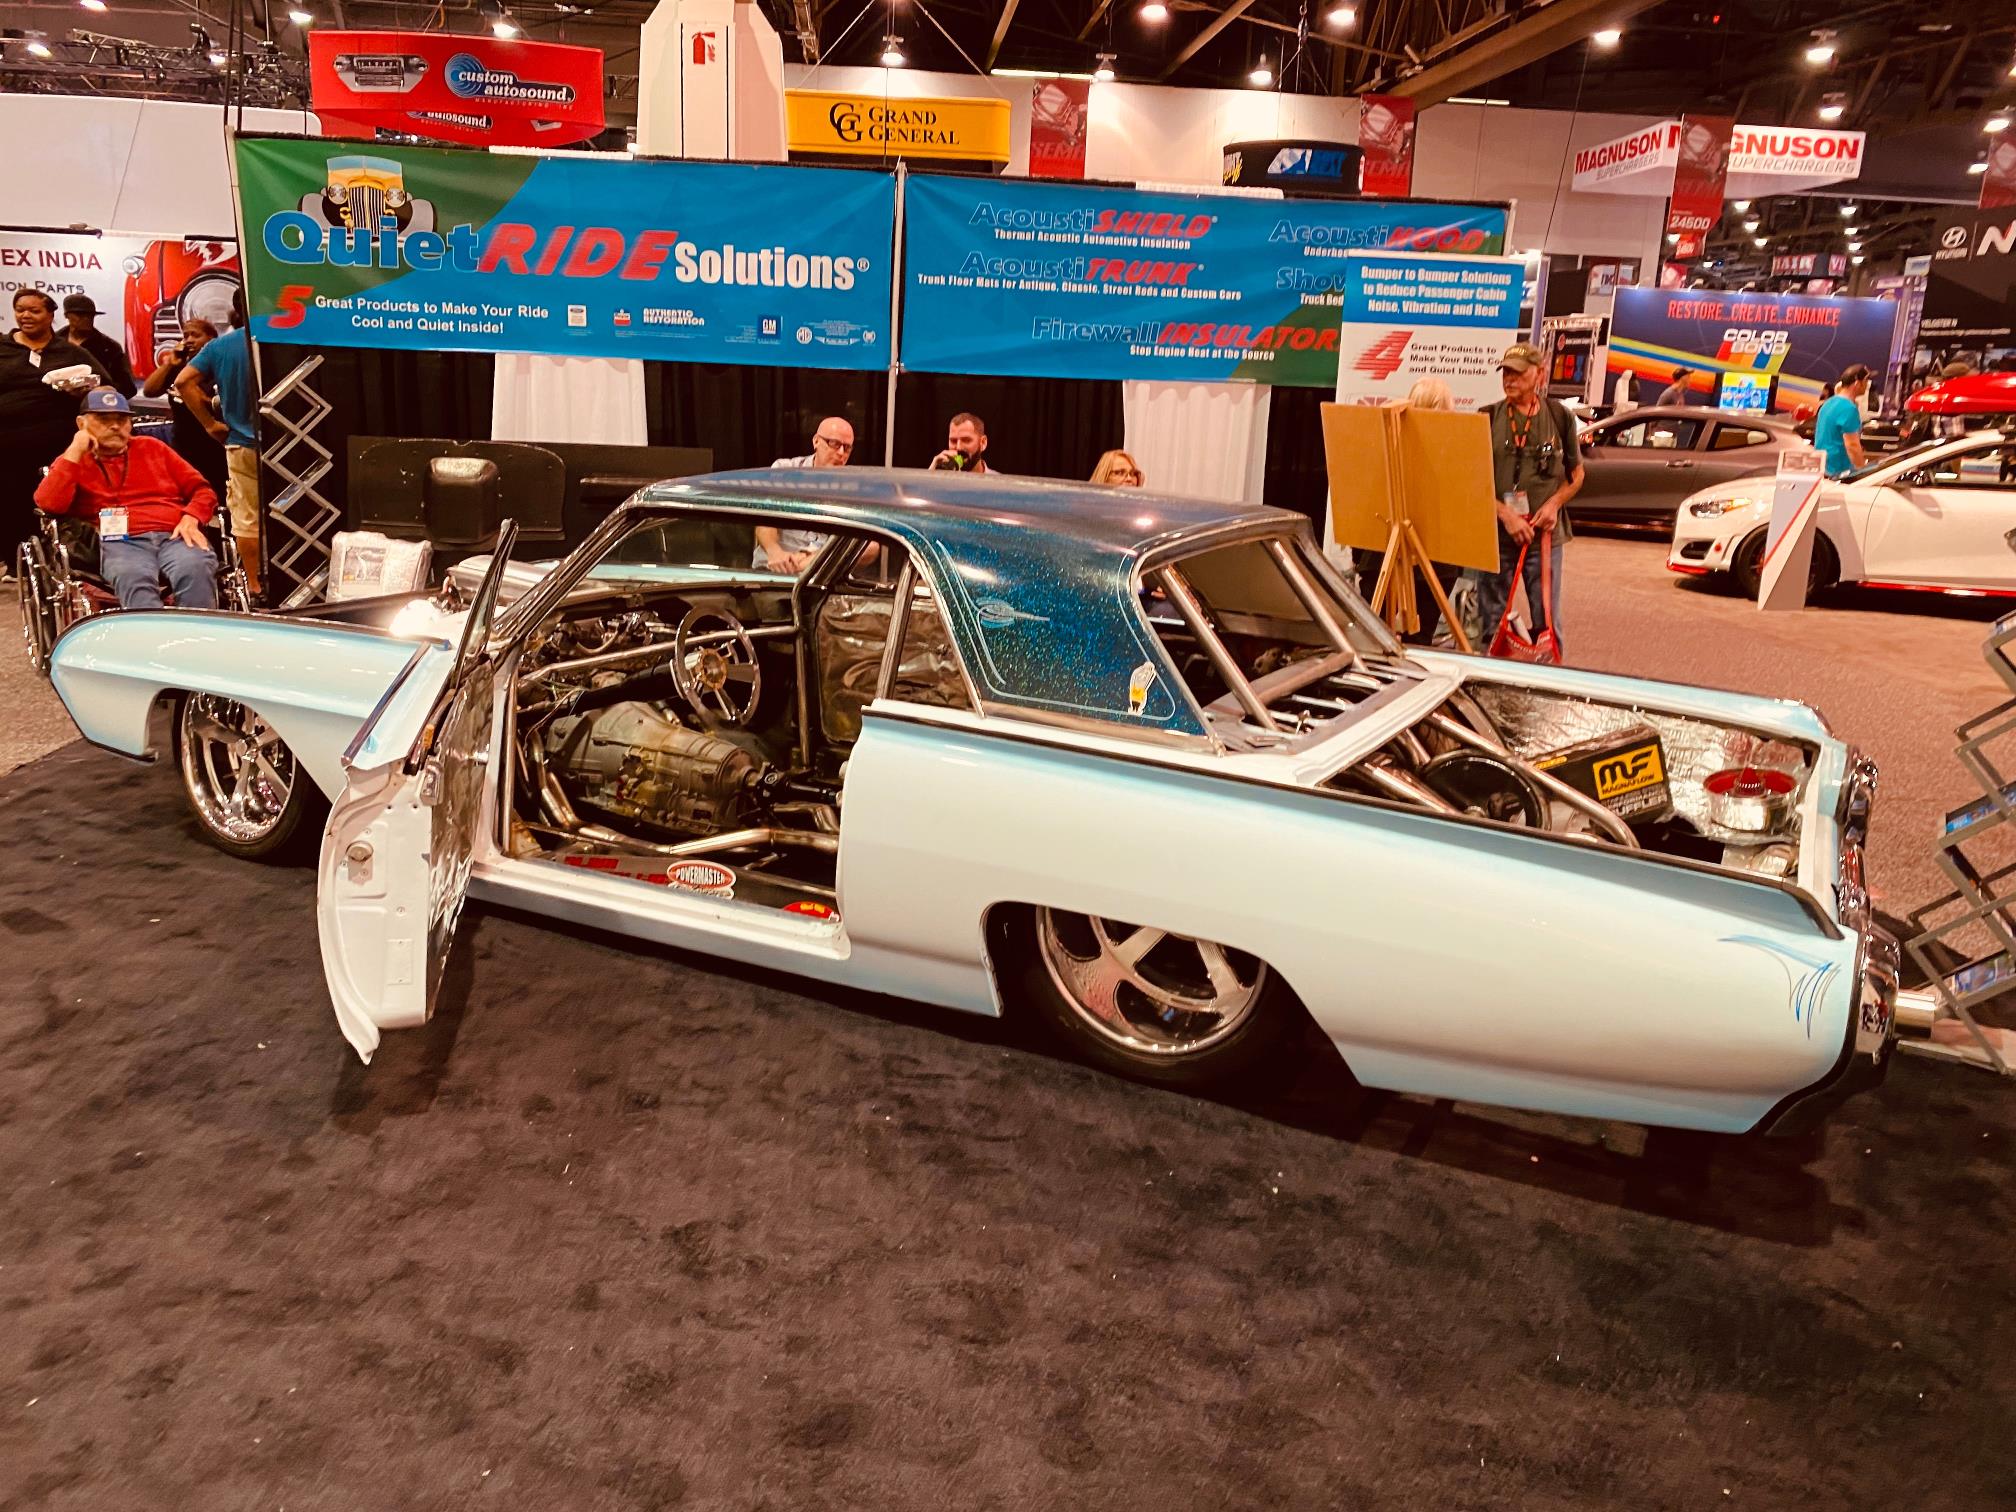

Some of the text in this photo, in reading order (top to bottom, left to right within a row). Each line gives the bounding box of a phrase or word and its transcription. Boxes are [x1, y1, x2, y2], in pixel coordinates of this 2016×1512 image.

[458, 70, 514, 85] custom
[869, 106, 937, 126] GRAND
[869, 125, 960, 145] GENERAL
[1575, 129, 1663, 175] MAGNUSON
[1596, 153, 1660, 181] SUPERCHARGERS
[994, 228, 1191, 250] Thermal Acoustic Automotive Insulation
[38, 251, 103, 270] INDIA
[1361, 265, 1512, 286] Bumper to Bumper Solutions
[918, 273, 946, 286] Trunk
[948, 275, 973, 287] Floor
[976, 277, 1000, 289] Mats
[1002, 278, 1016, 290] for
[1103, 283, 1132, 295] Street
[1135, 285, 1158, 297] Rods
[1160, 287, 1178, 298] and
[1181, 288, 1217, 300] Custom
[1219, 289, 1242, 301] Cars
[1363, 282, 1507, 301] to Reduce Passenger Cabin
[268, 285, 314, 328] 5
[315, 295, 549, 319] Great Products to Make Your Ride
[1300, 292, 1344, 306] Truck Bed
[1368, 299, 1499, 317] Noise, Vibration and Heat
[351, 315, 504, 334] Cool and Quiet Inside!
[643, 315, 705, 326] RESTORATION
[762, 318, 777, 333] GM
[1723, 328, 1789, 344] COLOR
[1130, 344, 1275, 361] Stop Engine Heat at the Source
[1352, 331, 1414, 380] 4
[1411, 343, 1437, 352] Great
[1441, 344, 1483, 354] Products
[1730, 340, 1786, 356] BOND
[1410, 354, 1435, 362] Make
[1440, 355, 1460, 364] Your
[1409, 365, 1487, 376] and Quiet Inside
[1602, 774, 1655, 795] MAGNAFLOW
[675, 866, 726, 885] POWERMASTER
